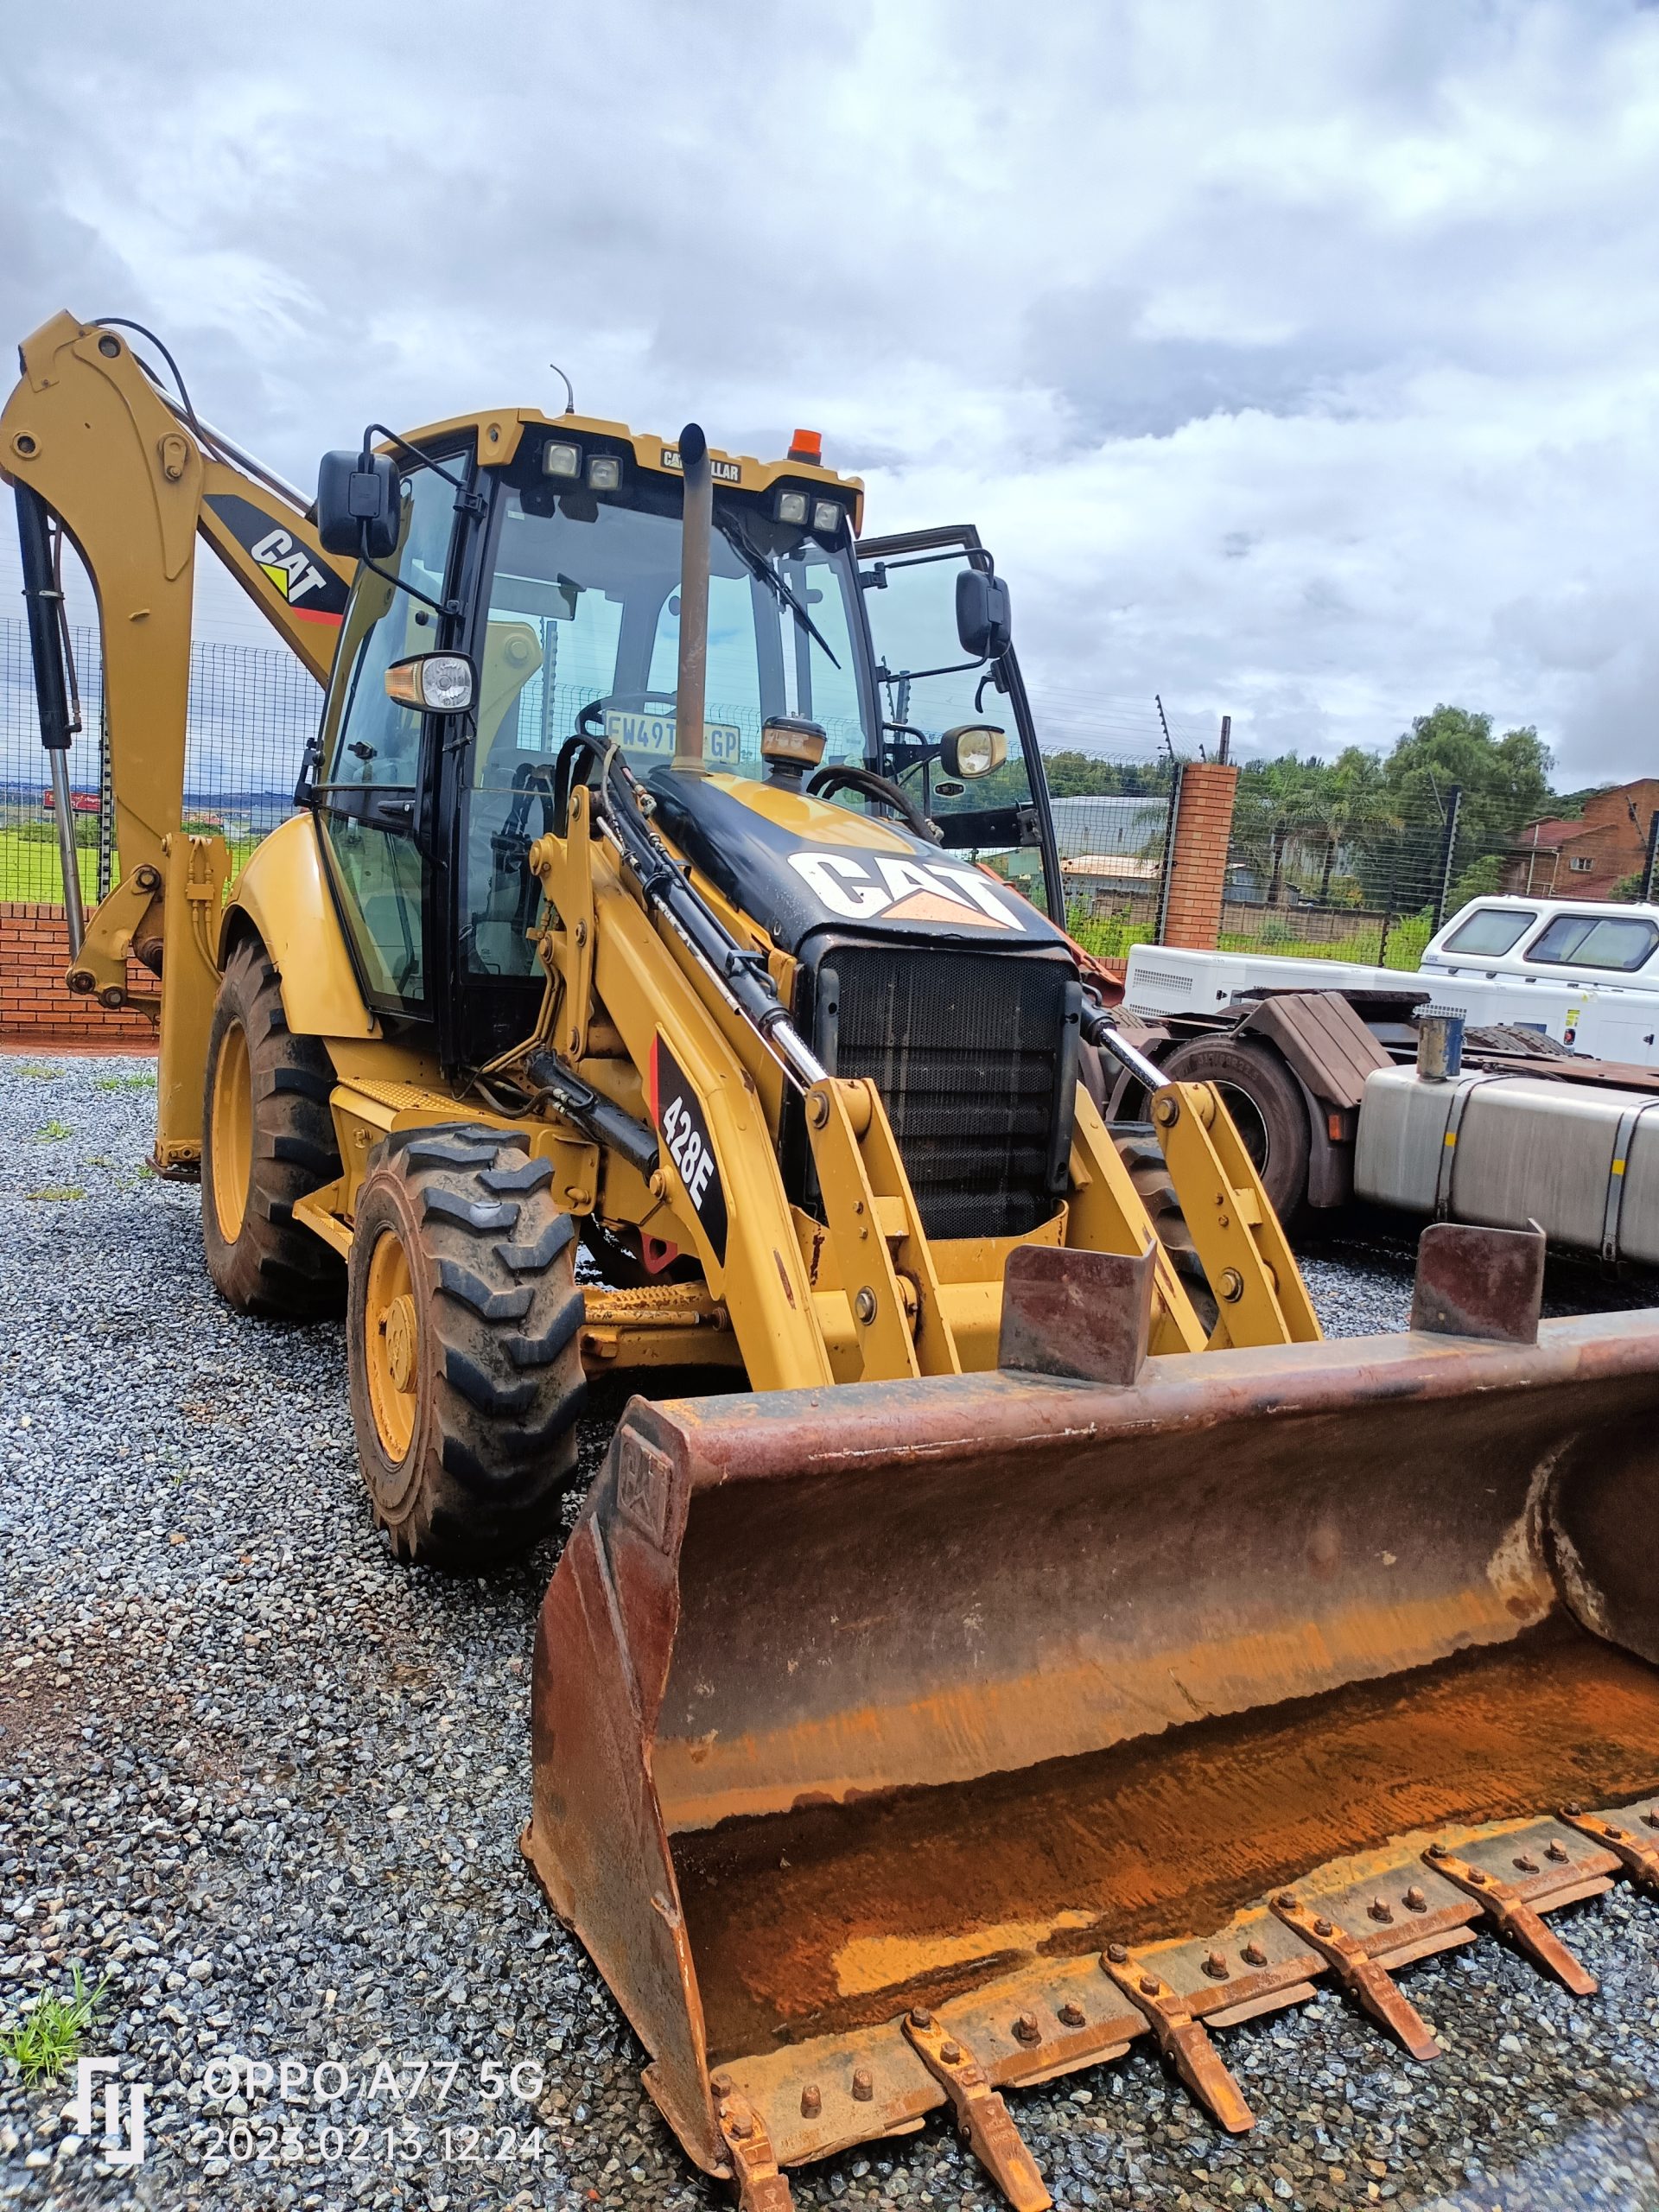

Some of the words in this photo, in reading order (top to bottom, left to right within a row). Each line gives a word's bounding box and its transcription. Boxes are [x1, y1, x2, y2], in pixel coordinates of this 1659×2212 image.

[664, 450, 739, 481] CALLAR
[251, 529, 327, 603] CAT
[711, 729, 737, 759] GP
[786, 852, 1027, 932] CAT
[663, 1096, 715, 1211] 428E
